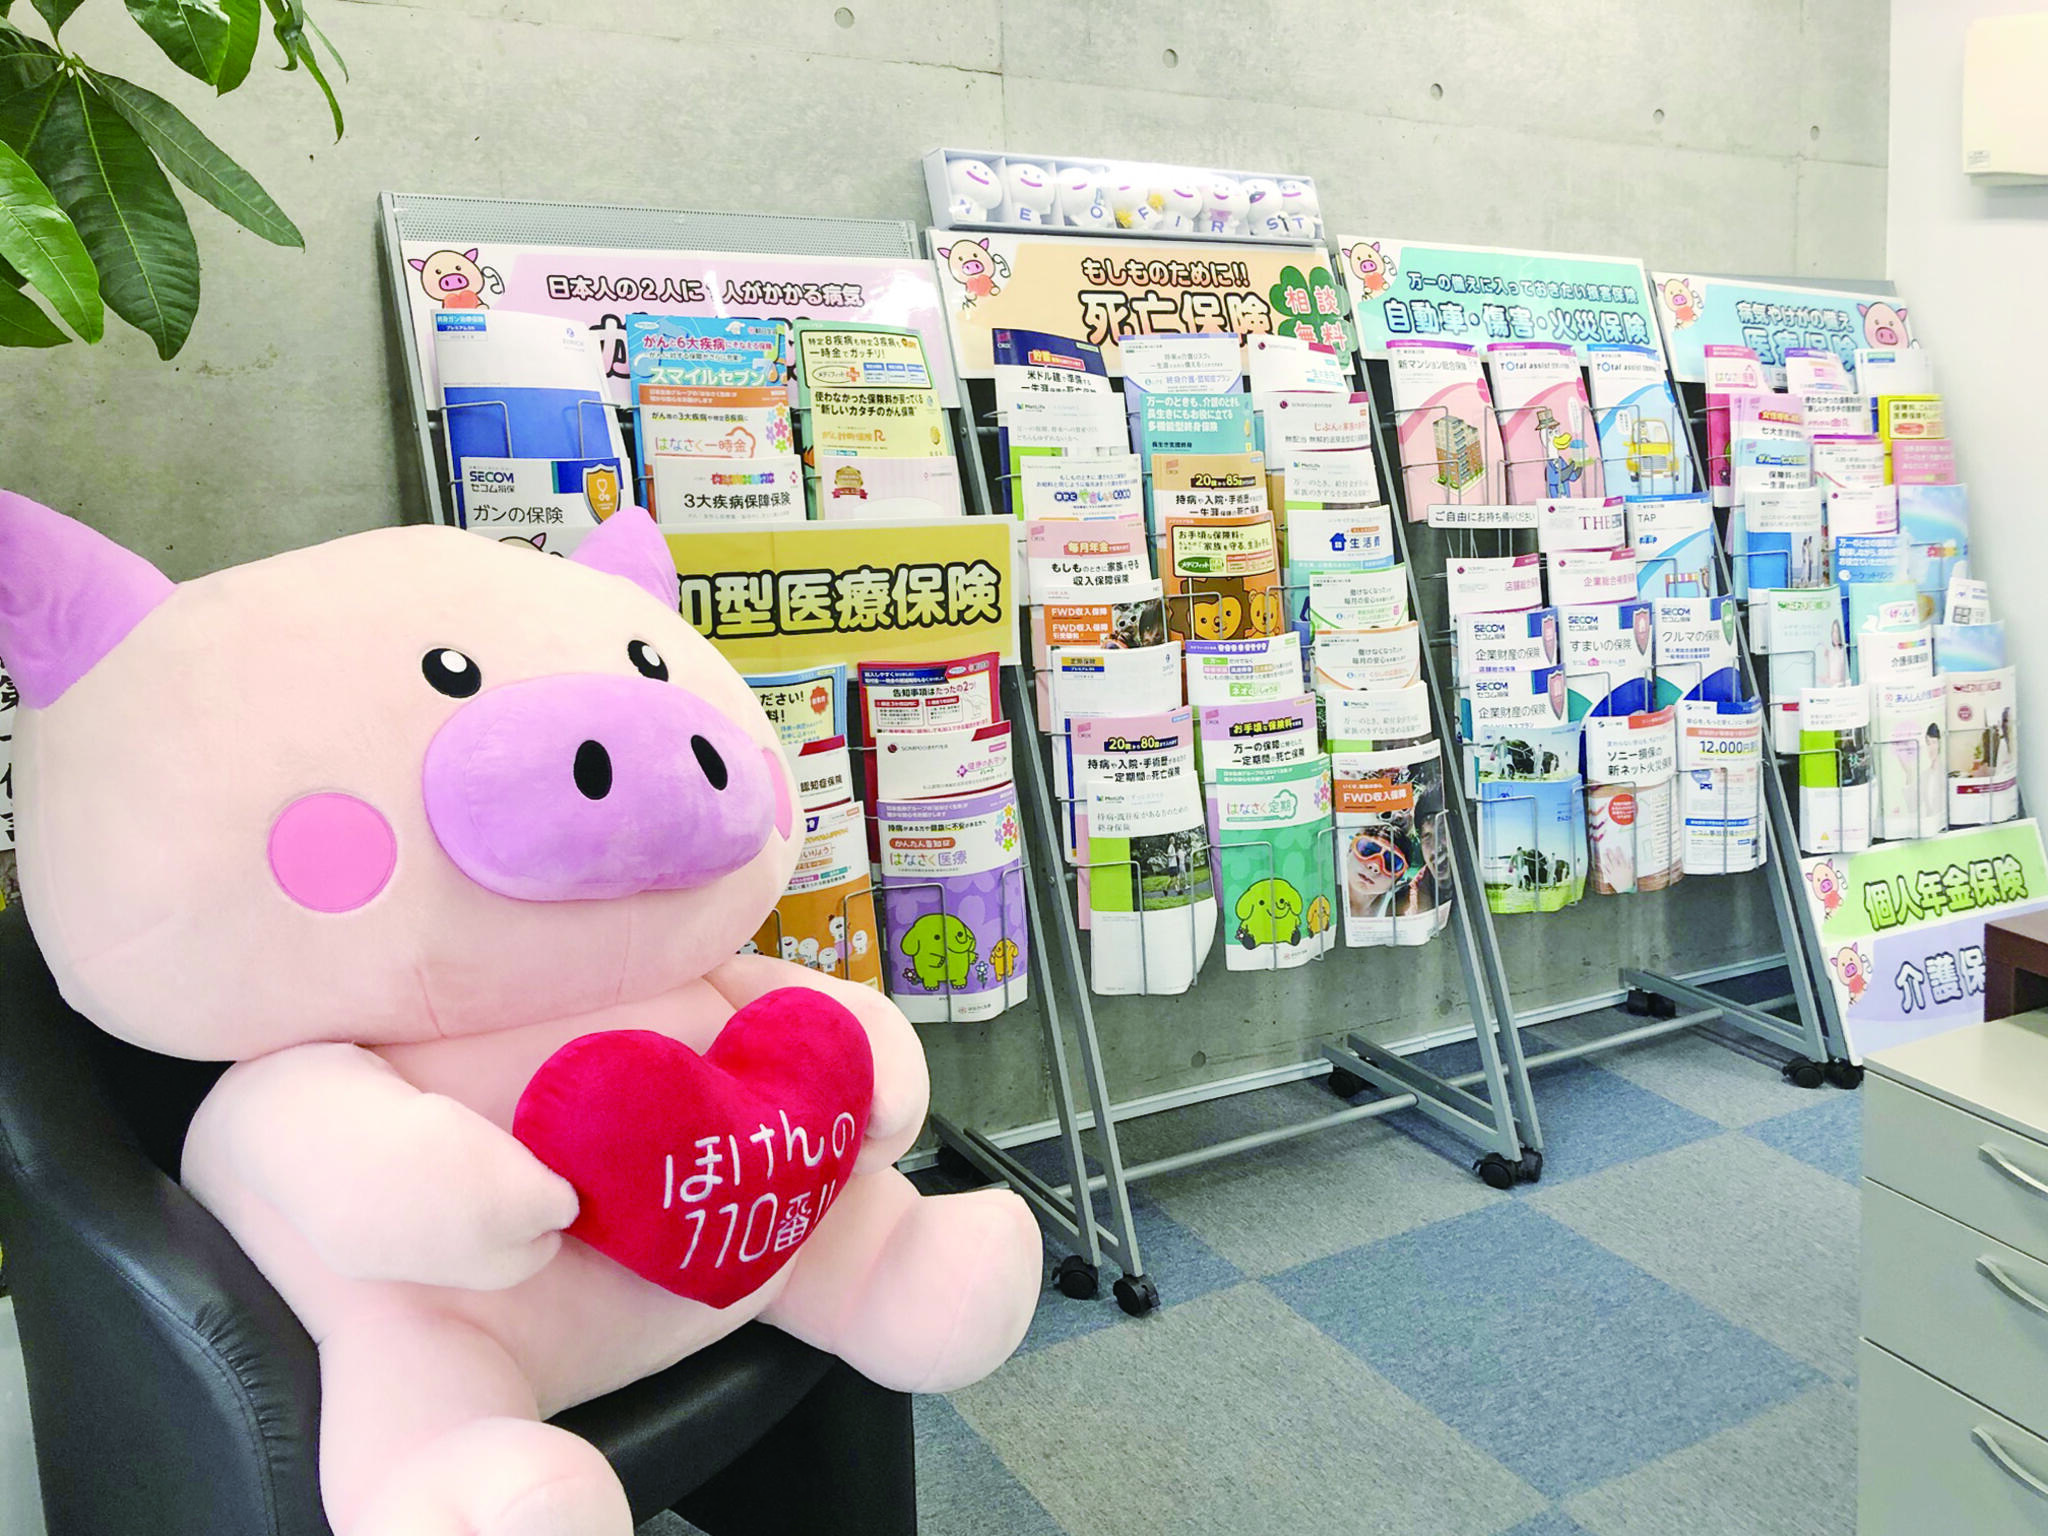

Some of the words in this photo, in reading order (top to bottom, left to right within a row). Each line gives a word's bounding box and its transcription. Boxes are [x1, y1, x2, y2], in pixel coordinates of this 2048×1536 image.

[1407, 271, 1639, 304] 万一の備えに入っておきたい損害保険
[1285, 285, 1340, 315] 相談
[1077, 290, 1274, 347] 死亡保険
[1384, 300, 1650, 344] 自動車・傷害・火災保険
[1294, 319, 1348, 352] 無料
[1500, 361, 1527, 372] Total
[1597, 362, 1622, 373] Total
[650, 367, 765, 386] スマイルセブン
[655, 436, 748, 454] はなさく一時金
[470, 471, 514, 483] SECOM
[471, 484, 515, 493] セコム損保
[683, 491, 792, 510] 3大疾病保障保険
[473, 504, 565, 524] ガンの保険
[1435, 510, 1536, 523] ご自由にお持ち帰りください
[1637, 514, 1657, 523] TAP
[1073, 574, 1130, 586] 収入保障保険
[1051, 607, 1108, 617] FWD収入保障
[1660, 607, 1691, 616] SECOM
[1567, 615, 1599, 625] SECOM
[1052, 623, 1109, 633] FWD収入保障
[1474, 624, 1506, 633] SECOM
[1661, 629, 1721, 643] クルマの保険
[1569, 638, 1633, 652] すまいの保険
[1475, 647, 1541, 661] 企業財産の保険
[1476, 682, 1509, 691] SECOM
[1478, 704, 1547, 719] 企業財産の保険
[1232, 748, 1306, 766] 一定期間の死亡保険
[1608, 746, 1663, 762] ソニー損保の
[1104, 767, 1182, 783] 一定期間の死亡保険
[1343, 789, 1407, 803] FWD収入保障
[1226, 799, 1293, 816] はなさく定期
[889, 850, 968, 867] はなさく医療
[1864, 854, 2028, 931] 個人年金保険
[663, 1109, 855, 1210] ほけんの
